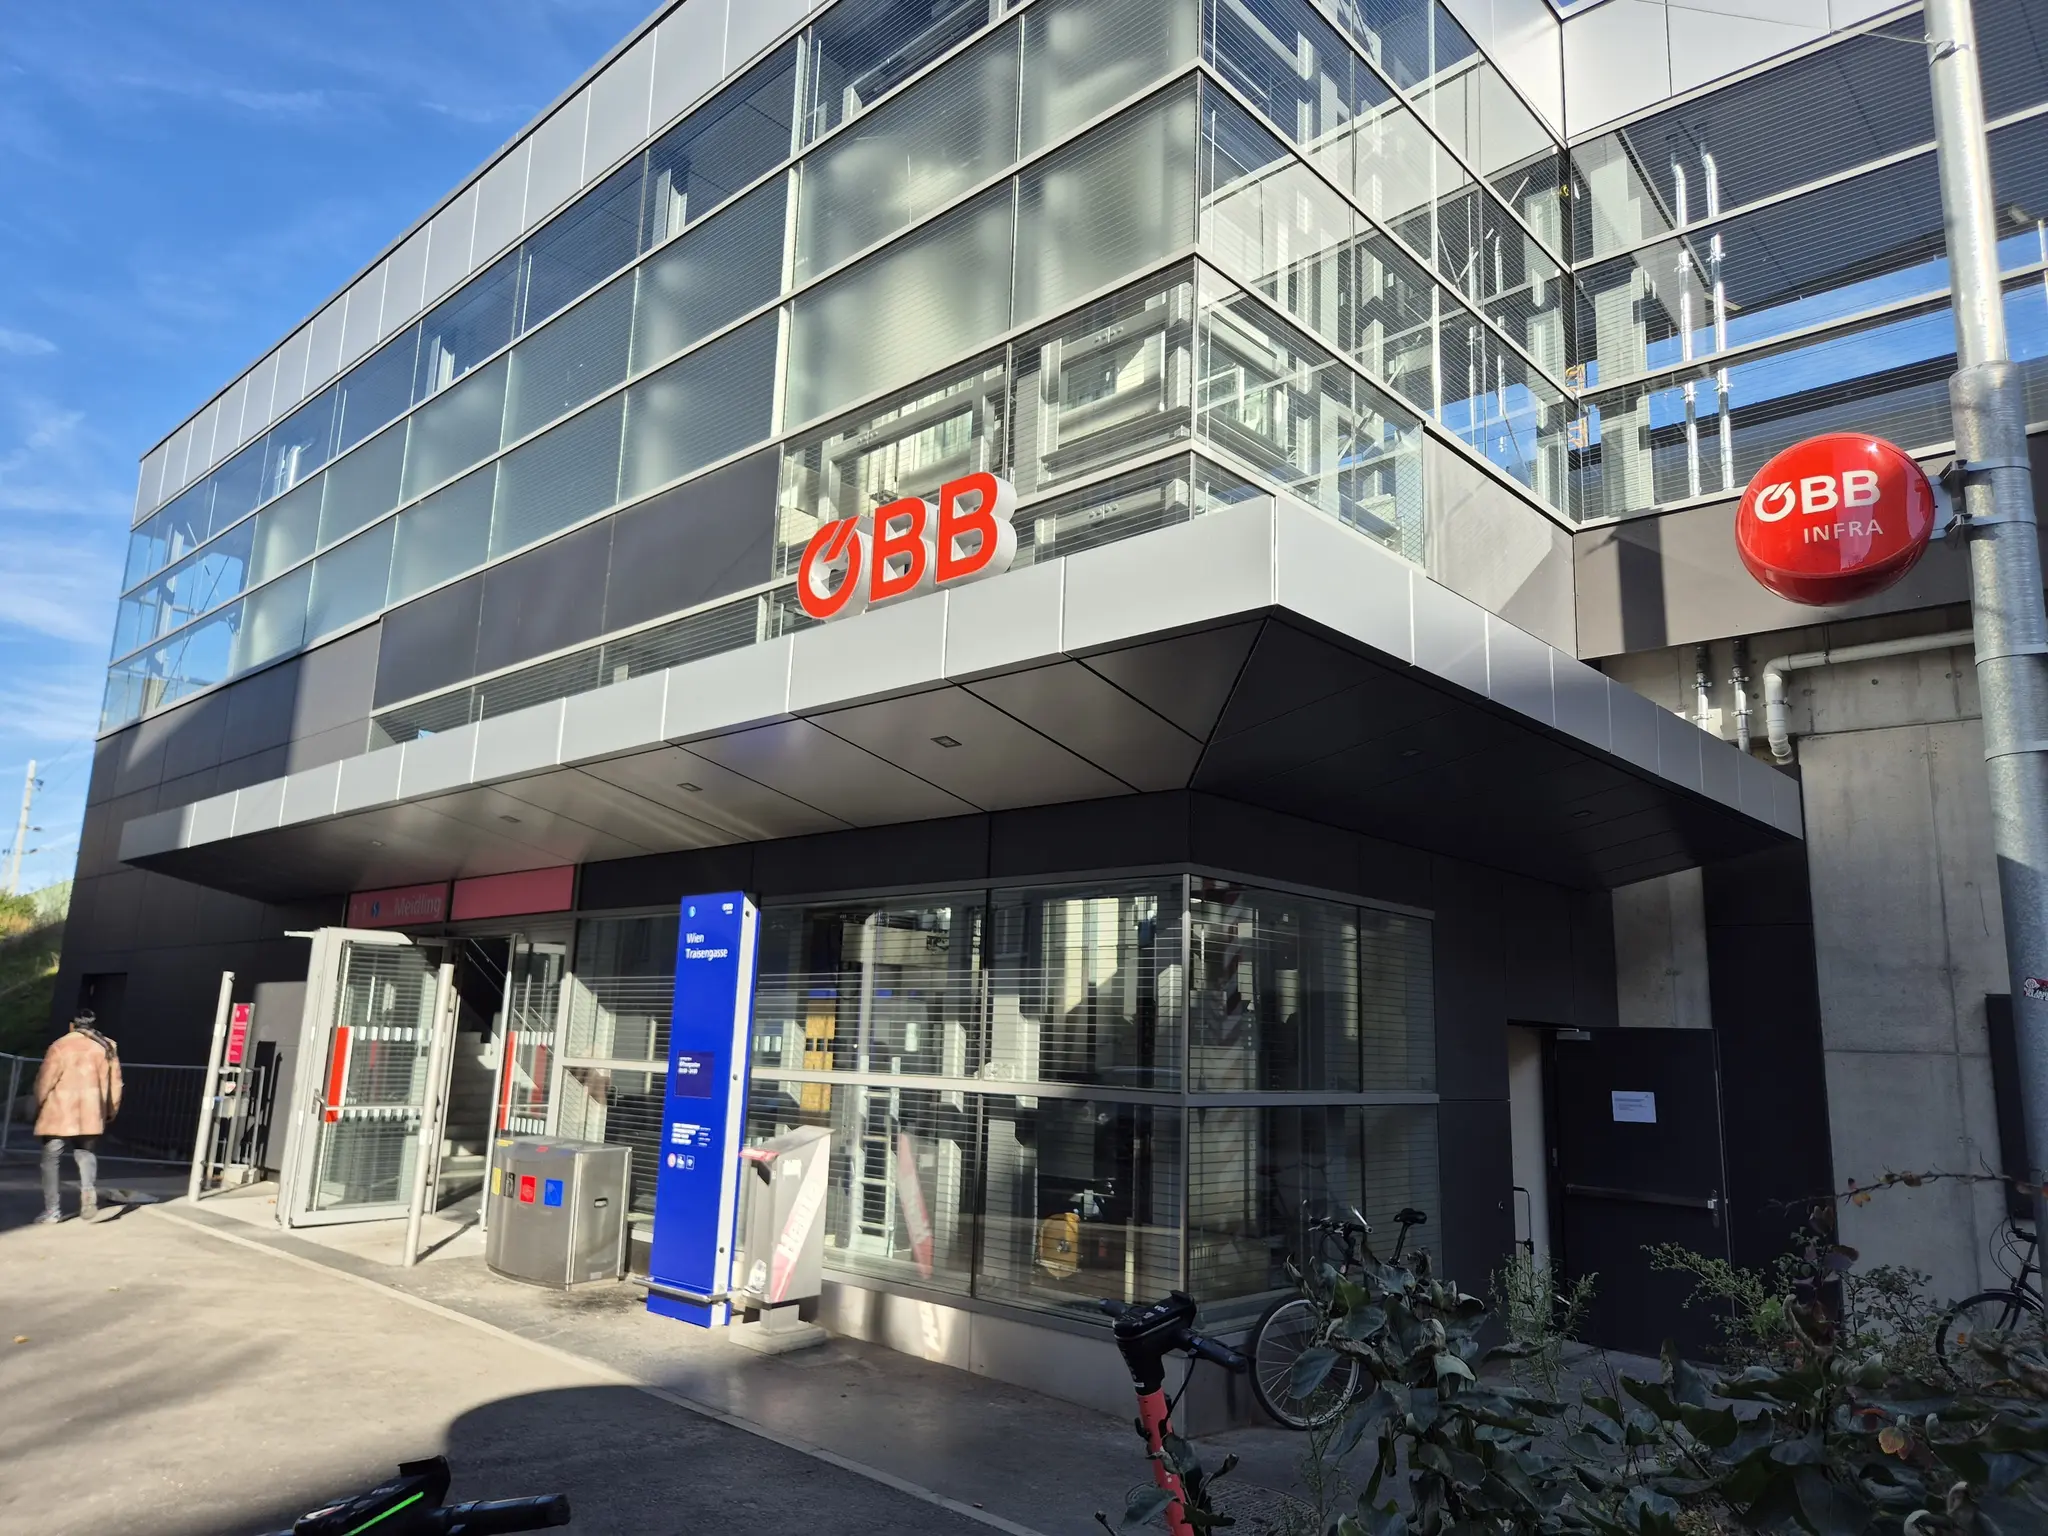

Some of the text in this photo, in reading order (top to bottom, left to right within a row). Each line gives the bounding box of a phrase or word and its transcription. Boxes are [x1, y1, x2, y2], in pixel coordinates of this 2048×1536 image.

[1754, 469, 1881, 523] ÖBB
[1803, 519, 1884, 544] INFRA
[797, 472, 1004, 619] ÖBB
[394, 893, 441, 919] Meidling
[686, 932, 705, 944] Wien
[685, 947, 729, 962] Traisengasse
